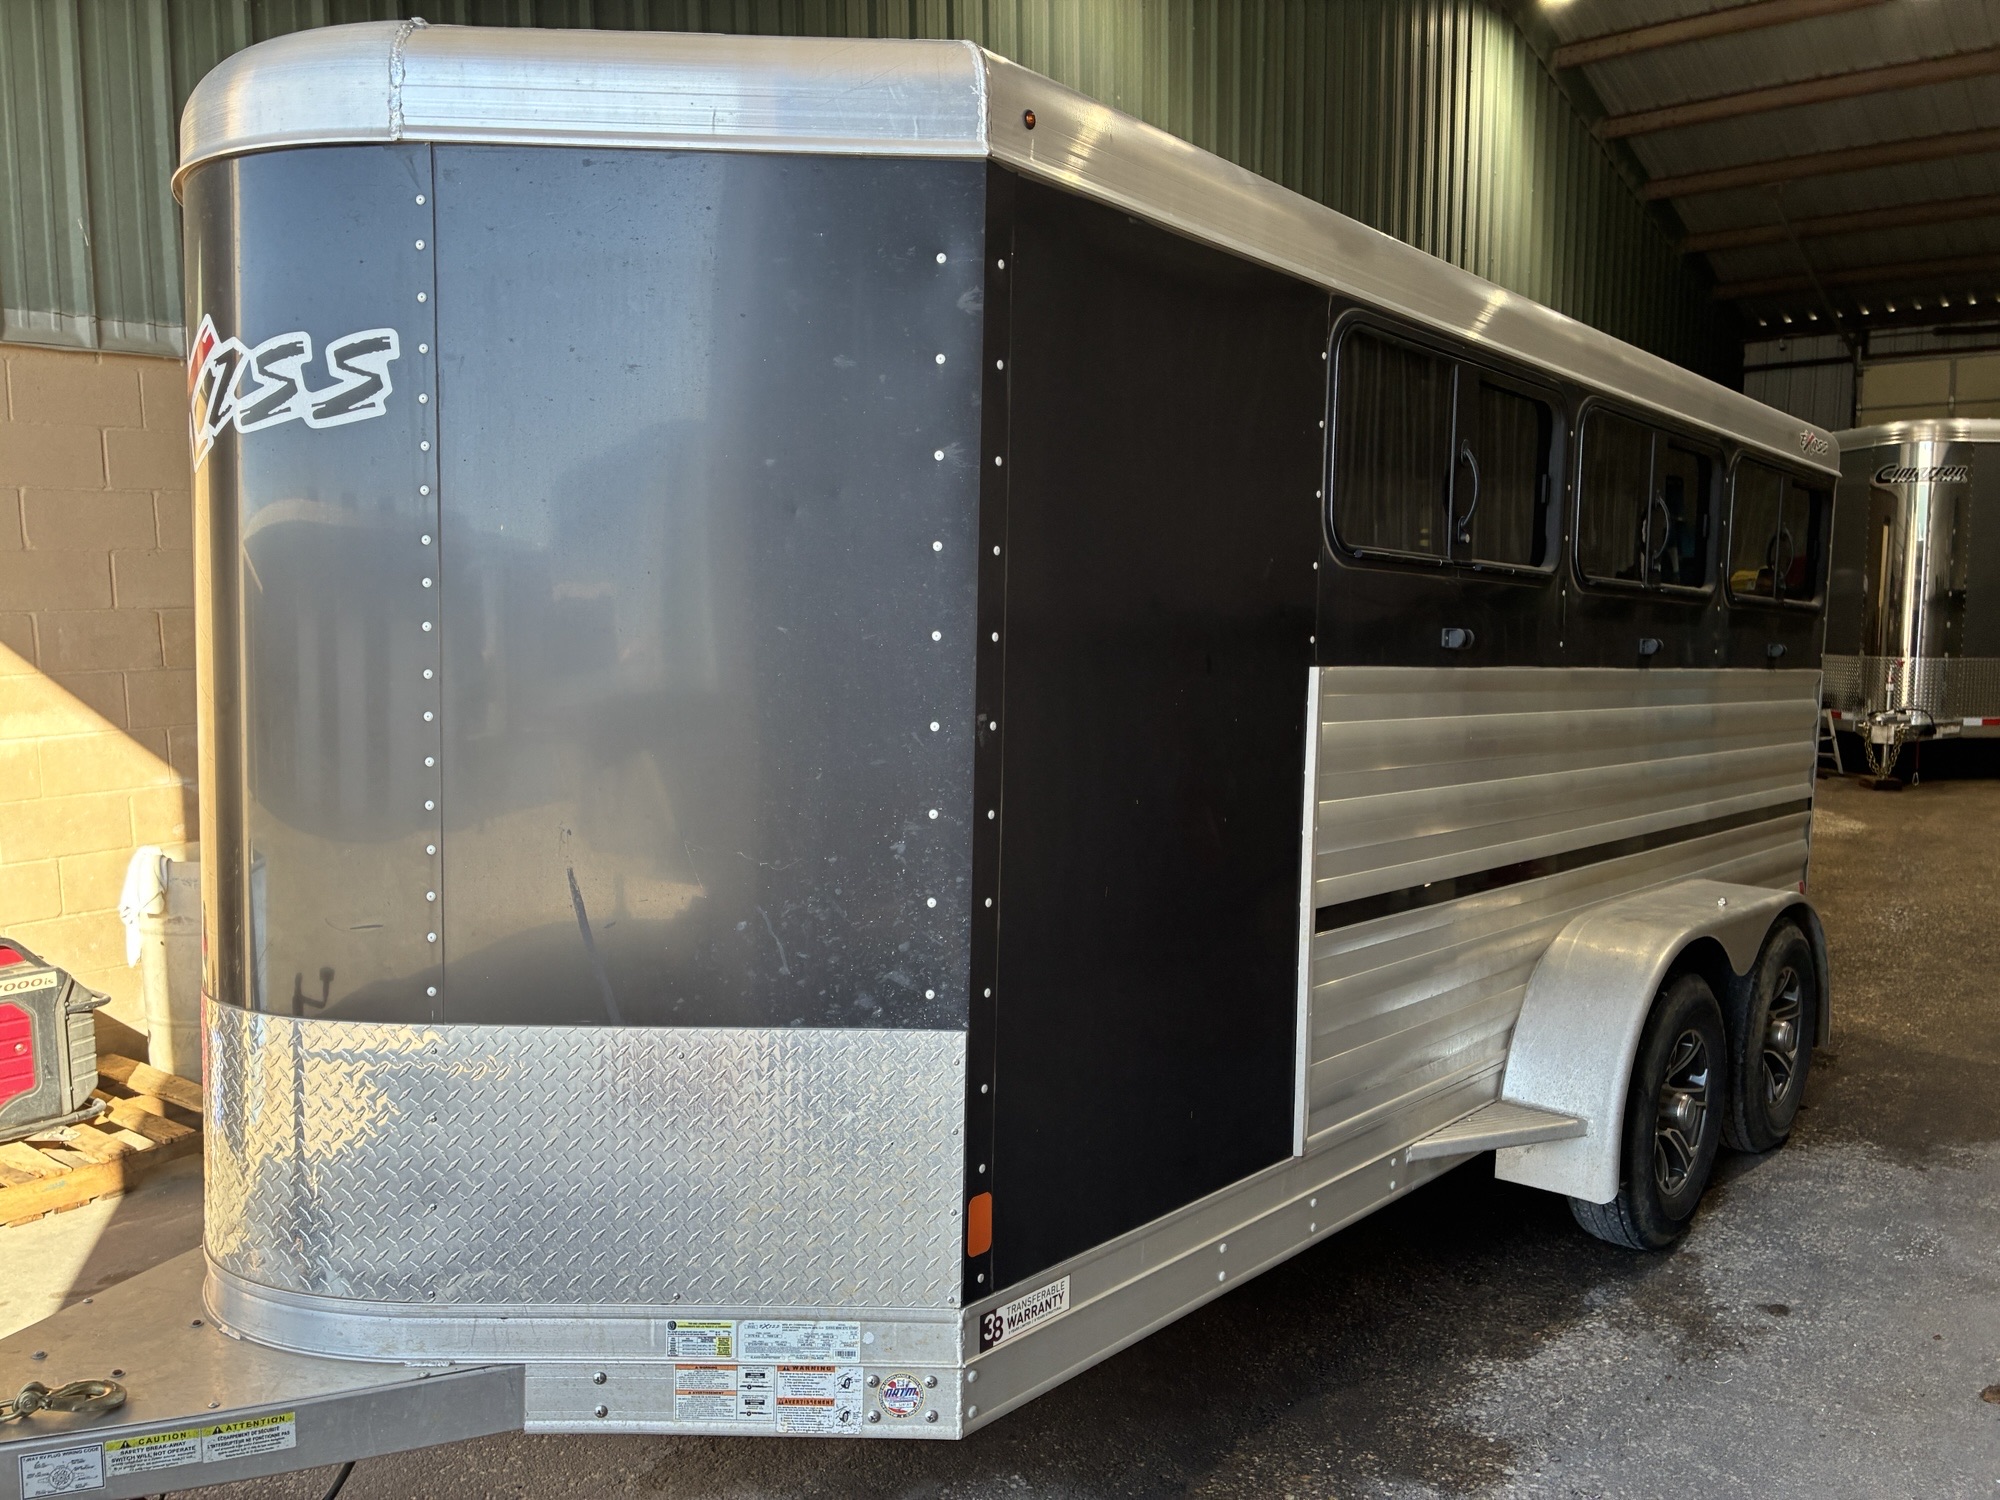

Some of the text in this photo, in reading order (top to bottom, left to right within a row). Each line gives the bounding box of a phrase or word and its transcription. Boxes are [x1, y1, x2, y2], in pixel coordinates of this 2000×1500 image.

[1007, 1281, 1065, 1316] TRANSFERABLE
[1007, 1291, 1065, 1330] WARRANTY
[984, 1313, 1004, 1342] 38
[225, 1416, 285, 1432] ATTENTION
[138, 1432, 187, 1445] CAUTION
[111, 1454, 136, 1463] SWITCH
[137, 1452, 152, 1460] WILL
[167, 1445, 196, 1454] OPERATE
[120, 1441, 186, 1455] SAFETY BREAK-AWAY
